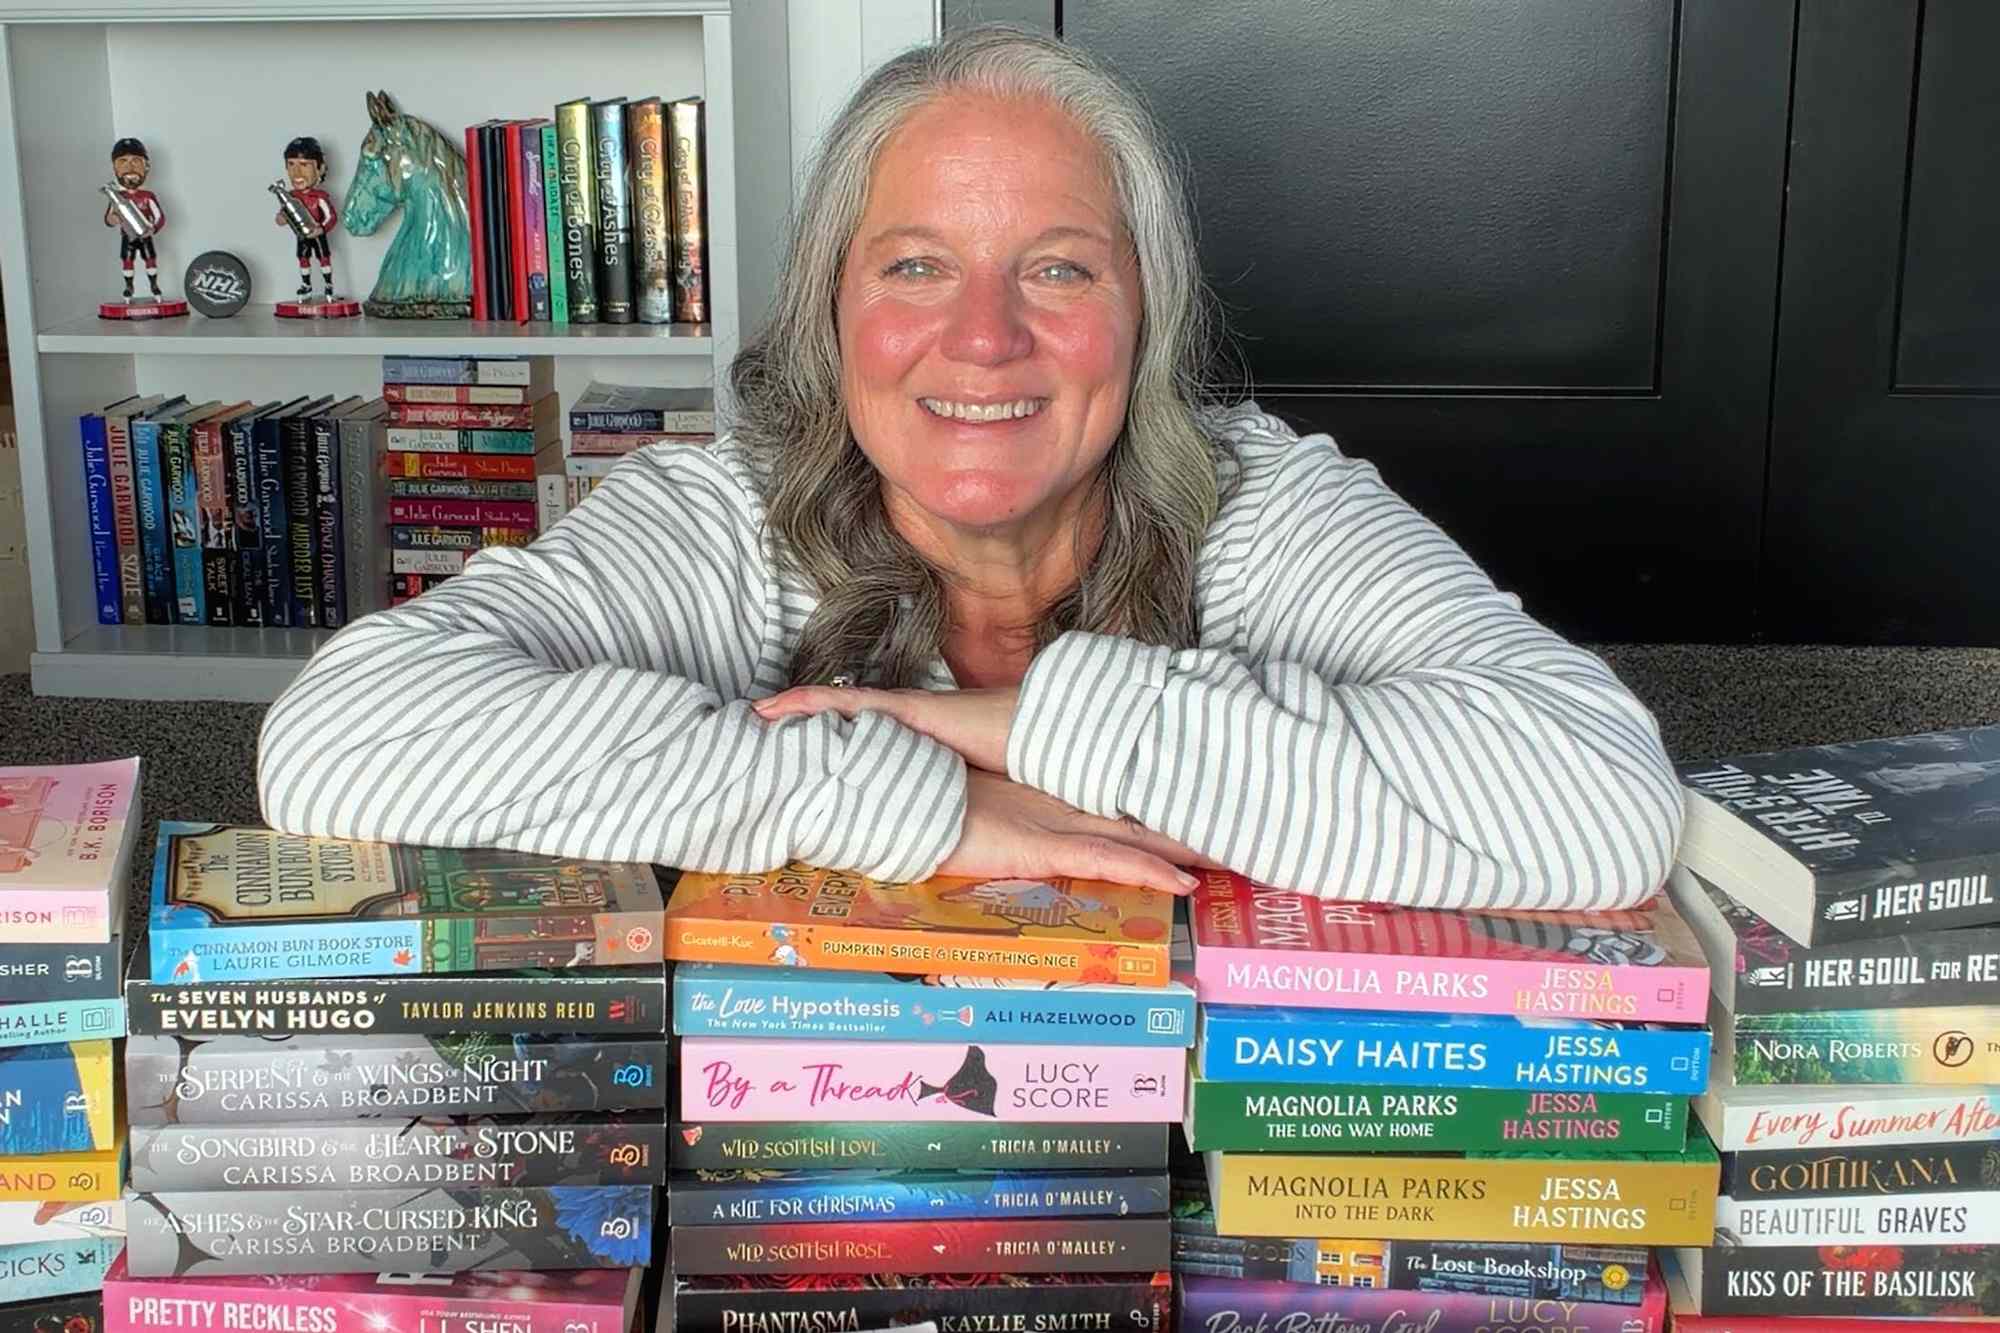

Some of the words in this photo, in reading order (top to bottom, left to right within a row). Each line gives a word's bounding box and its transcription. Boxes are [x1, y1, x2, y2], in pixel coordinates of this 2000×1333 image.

[561, 139, 581, 184] City
[597, 137, 617, 180] City
[637, 138, 655, 181] City
[673, 137, 690, 168] City
[680, 173, 692, 186] of
[566, 191, 581, 209] of
[601, 188, 617, 205] of
[641, 187, 657, 203] of
[603, 206, 620, 265] Ashes
[642, 204, 662, 259] Glass
[568, 215, 585, 280] Bones
[195, 273, 246, 296] NHL
[111, 426, 128, 467] JULIE
[167, 430, 180, 453] JULIE
[195, 431, 207, 453] JULIE
[231, 431, 244, 454] JULIE
[85, 441, 103, 473] Julie
[137, 449, 148, 473] JULIE
[258, 443, 277, 476] Julie
[172, 457, 183, 504] GARWOOD
[200, 457, 212, 502] GARWOOD
[236, 458, 248, 503] GARWOOD
[291, 456, 308, 515] GARWOOD
[88, 475, 110, 535] Garwood
[114, 475, 135, 546] GARWOOD
[140, 478, 155, 529] GARWOOD
[261, 479, 281, 538] Garwood
[290, 523, 310, 573] MURDER
[120, 554, 141, 595] SIZZLE
[207, 562, 216, 591] TALK
[217, 557, 227, 594] SWEET
[296, 576, 313, 599] LIST
[89, 784, 117, 831] BORISON
[80, 839, 103, 860] B.K.
[1873, 884, 1923, 919] HER
[1929, 875, 1993, 905] SOUL
[194, 941, 280, 956] CINNAMON
[283, 940, 316, 953] BUN
[319, 938, 360, 952] BOOK
[364, 935, 414, 948] STORE
[823, 940, 885, 957] PUMPKIN
[890, 945, 930, 960] SPICE
[935, 947, 947, 959] &
[952, 950, 1037, 967] EVERYTHING
[1043, 954, 1077, 968] NICE
[213, 955, 281, 971] LAURIE
[287, 952, 372, 968] GILMORE
[1806, 960, 1852, 987] HER
[1859, 957, 1925, 985] SOUL
[1931, 962, 1960, 979] FOR
[1226, 965, 1382, 992] MAGNOLIA
[1396, 971, 1489, 998] PARKS
[178, 991, 249, 1004] SEVEN
[255, 991, 367, 1004] HUSBANDS
[690, 992, 716, 1013] the
[719, 988, 766, 1016] Love
[773, 994, 900, 1018] Hypothesis
[161, 1012, 280, 1030] EVELYN
[287, 1010, 375, 1028] HUGO
[402, 1003, 464, 1020] TAYLOR
[473, 1003, 550, 1020] JENKINS
[555, 1003, 595, 1020] REID
[985, 1011, 1014, 1024] ALI
[1020, 1011, 1136, 1026] HAZELWOOD
[707, 1018, 728, 1029] The
[733, 1020, 757, 1030] New
[762, 1020, 785, 1031] York
[791, 1021, 824, 1032] Times
[829, 1022, 886, 1034] Bestseller
[1236, 1038, 1343, 1066] DAISY
[1357, 1044, 1488, 1071] HAITES
[1544, 1036, 1621, 1058] JESSA
[1754, 1039, 1819, 1062] NORA
[1830, 1039, 1921, 1063] ROBERTS
[176, 1062, 308, 1100] SERPENT
[357, 1063, 442, 1085] WINGS
[463, 1055, 548, 1083] NIGHT
[703, 1061, 755, 1104] By
[770, 1078, 794, 1093] a
[803, 1064, 917, 1106] Thread
[1025, 1064, 1100, 1083] LUCY
[1516, 1064, 1648, 1086] HASTINGS
[220, 1093, 329, 1112] CARISSA
[341, 1085, 498, 1107] BROADBENT
[1013, 1086, 1109, 1108] SCORE
[1245, 1096, 1372, 1117] MAGNOLIA
[1383, 1096, 1457, 1116] PARKS
[1526, 1092, 1597, 1113] JESSA
[1267, 1124, 1297, 1138] THE
[1302, 1124, 1346, 1137] LONG
[1351, 1123, 1384, 1137] WAY
[1389, 1123, 1434, 1137] HOME
[1502, 1119, 1621, 1140] HASTINGS
[1745, 1110, 1827, 1145] Every
[1830, 1105, 1943, 1140] Summer
[176, 1135, 315, 1165] SONGBIRD
[365, 1133, 456, 1159] HEART
[474, 1129, 575, 1158] STONE
[991, 1140, 1037, 1154] TRICIA
[1043, 1140, 1110, 1154] O'MALLEY
[1247, 1176, 1388, 1198] MAGNOLIA
[1402, 1179, 1486, 1200] PARKS
[1750, 1156, 1958, 1193] GOTHIKANA
[994, 1193, 1040, 1208] TRICIA
[1046, 1192, 1113, 1207] O'MALLEY
[1541, 1178, 1621, 1201] JESSA
[160, 1210, 245, 1235] ASHES
[282, 1206, 466, 1235] STAR-CURSED
[474, 1200, 539, 1229] KING
[712, 1205, 724, 1218] A
[730, 1200, 763, 1217] KILT
[769, 1199, 802, 1215] FOR
[808, 1196, 895, 1216] CHRISTMAS
[1295, 1206, 1339, 1220] INTO
[1343, 1206, 1380, 1220] THE
[1386, 1206, 1434, 1222] DARK
[1513, 1206, 1646, 1230] HASTINGS
[1739, 1208, 1865, 1235] BEAUTIFUL
[1878, 1206, 1968, 1233] GRAVES
[1431, 1255, 1475, 1273] Lost
[1485, 1256, 1587, 1284] Bookshop
[1728, 1271, 1775, 1297] KISS
[1783, 1271, 1814, 1297] OF
[1823, 1271, 1867, 1297] THE
[1874, 1270, 1976, 1297] BASILISK
[129, 1297, 216, 1328] PRETTY
[224, 1302, 337, 1333] RECKLESS
[722, 1308, 860, 1333] PHANTASMA
[941, 1314, 1027, 1333] KAYLIE
[1035, 1312, 1112, 1332] SMITH
